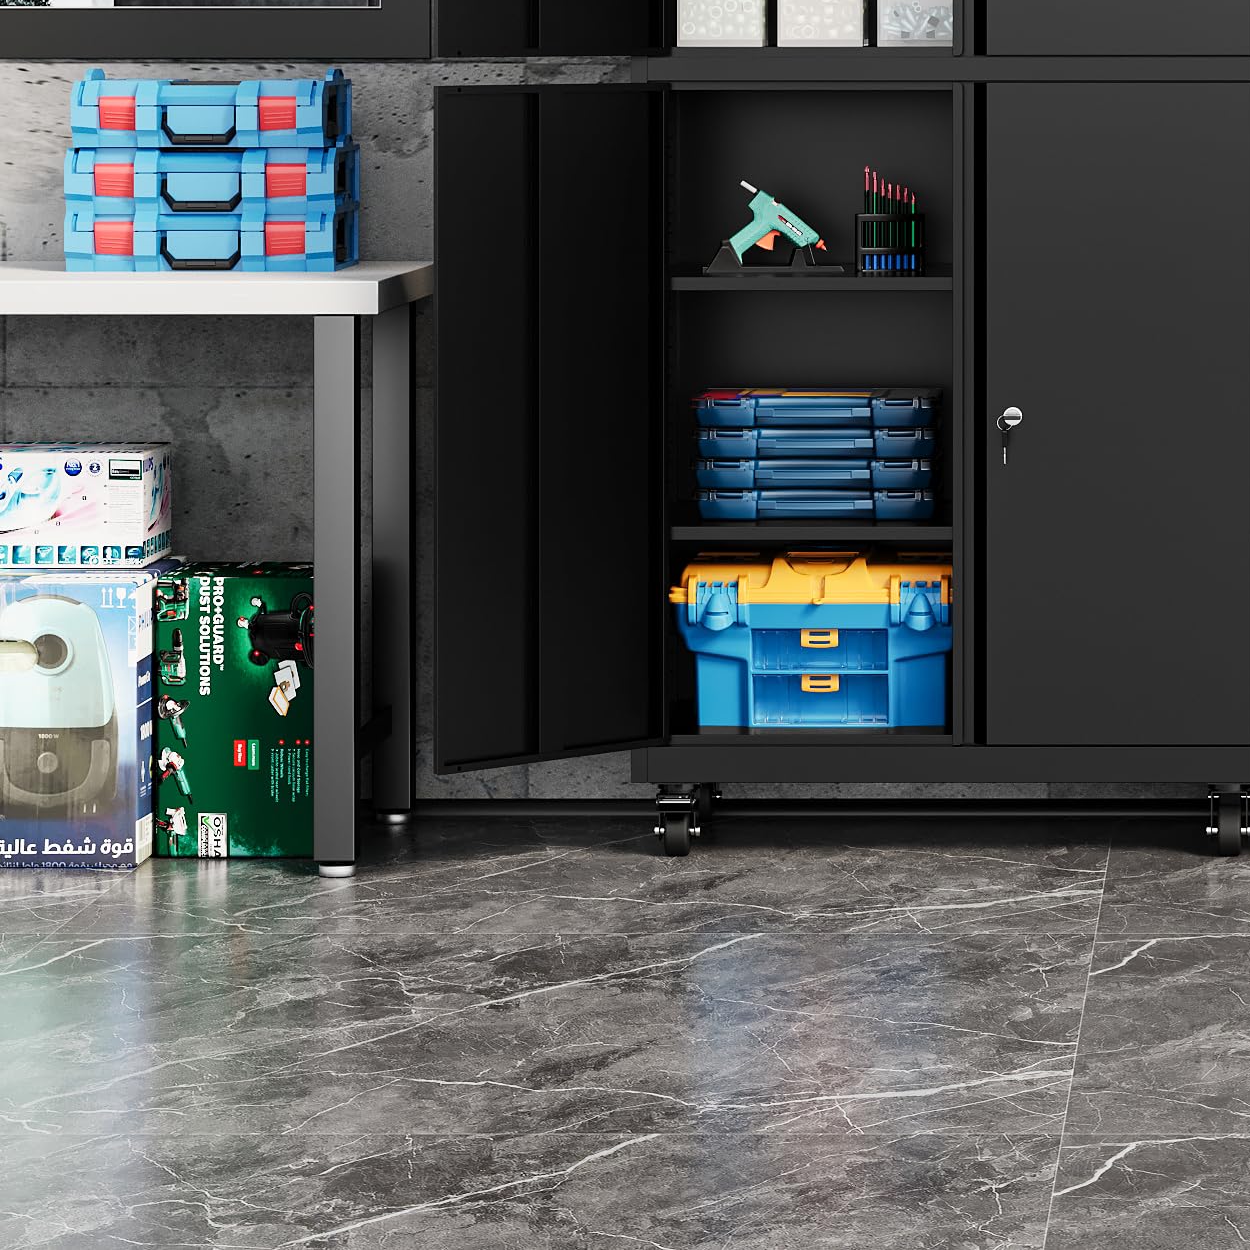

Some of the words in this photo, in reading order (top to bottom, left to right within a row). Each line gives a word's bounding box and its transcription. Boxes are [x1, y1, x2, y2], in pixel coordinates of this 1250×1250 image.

[199, 576, 211, 614] DUST
[199, 616, 211, 696] SOLUTIONS
[42, 836, 96, 854] شفط
[100, 838, 134, 858] قوة
